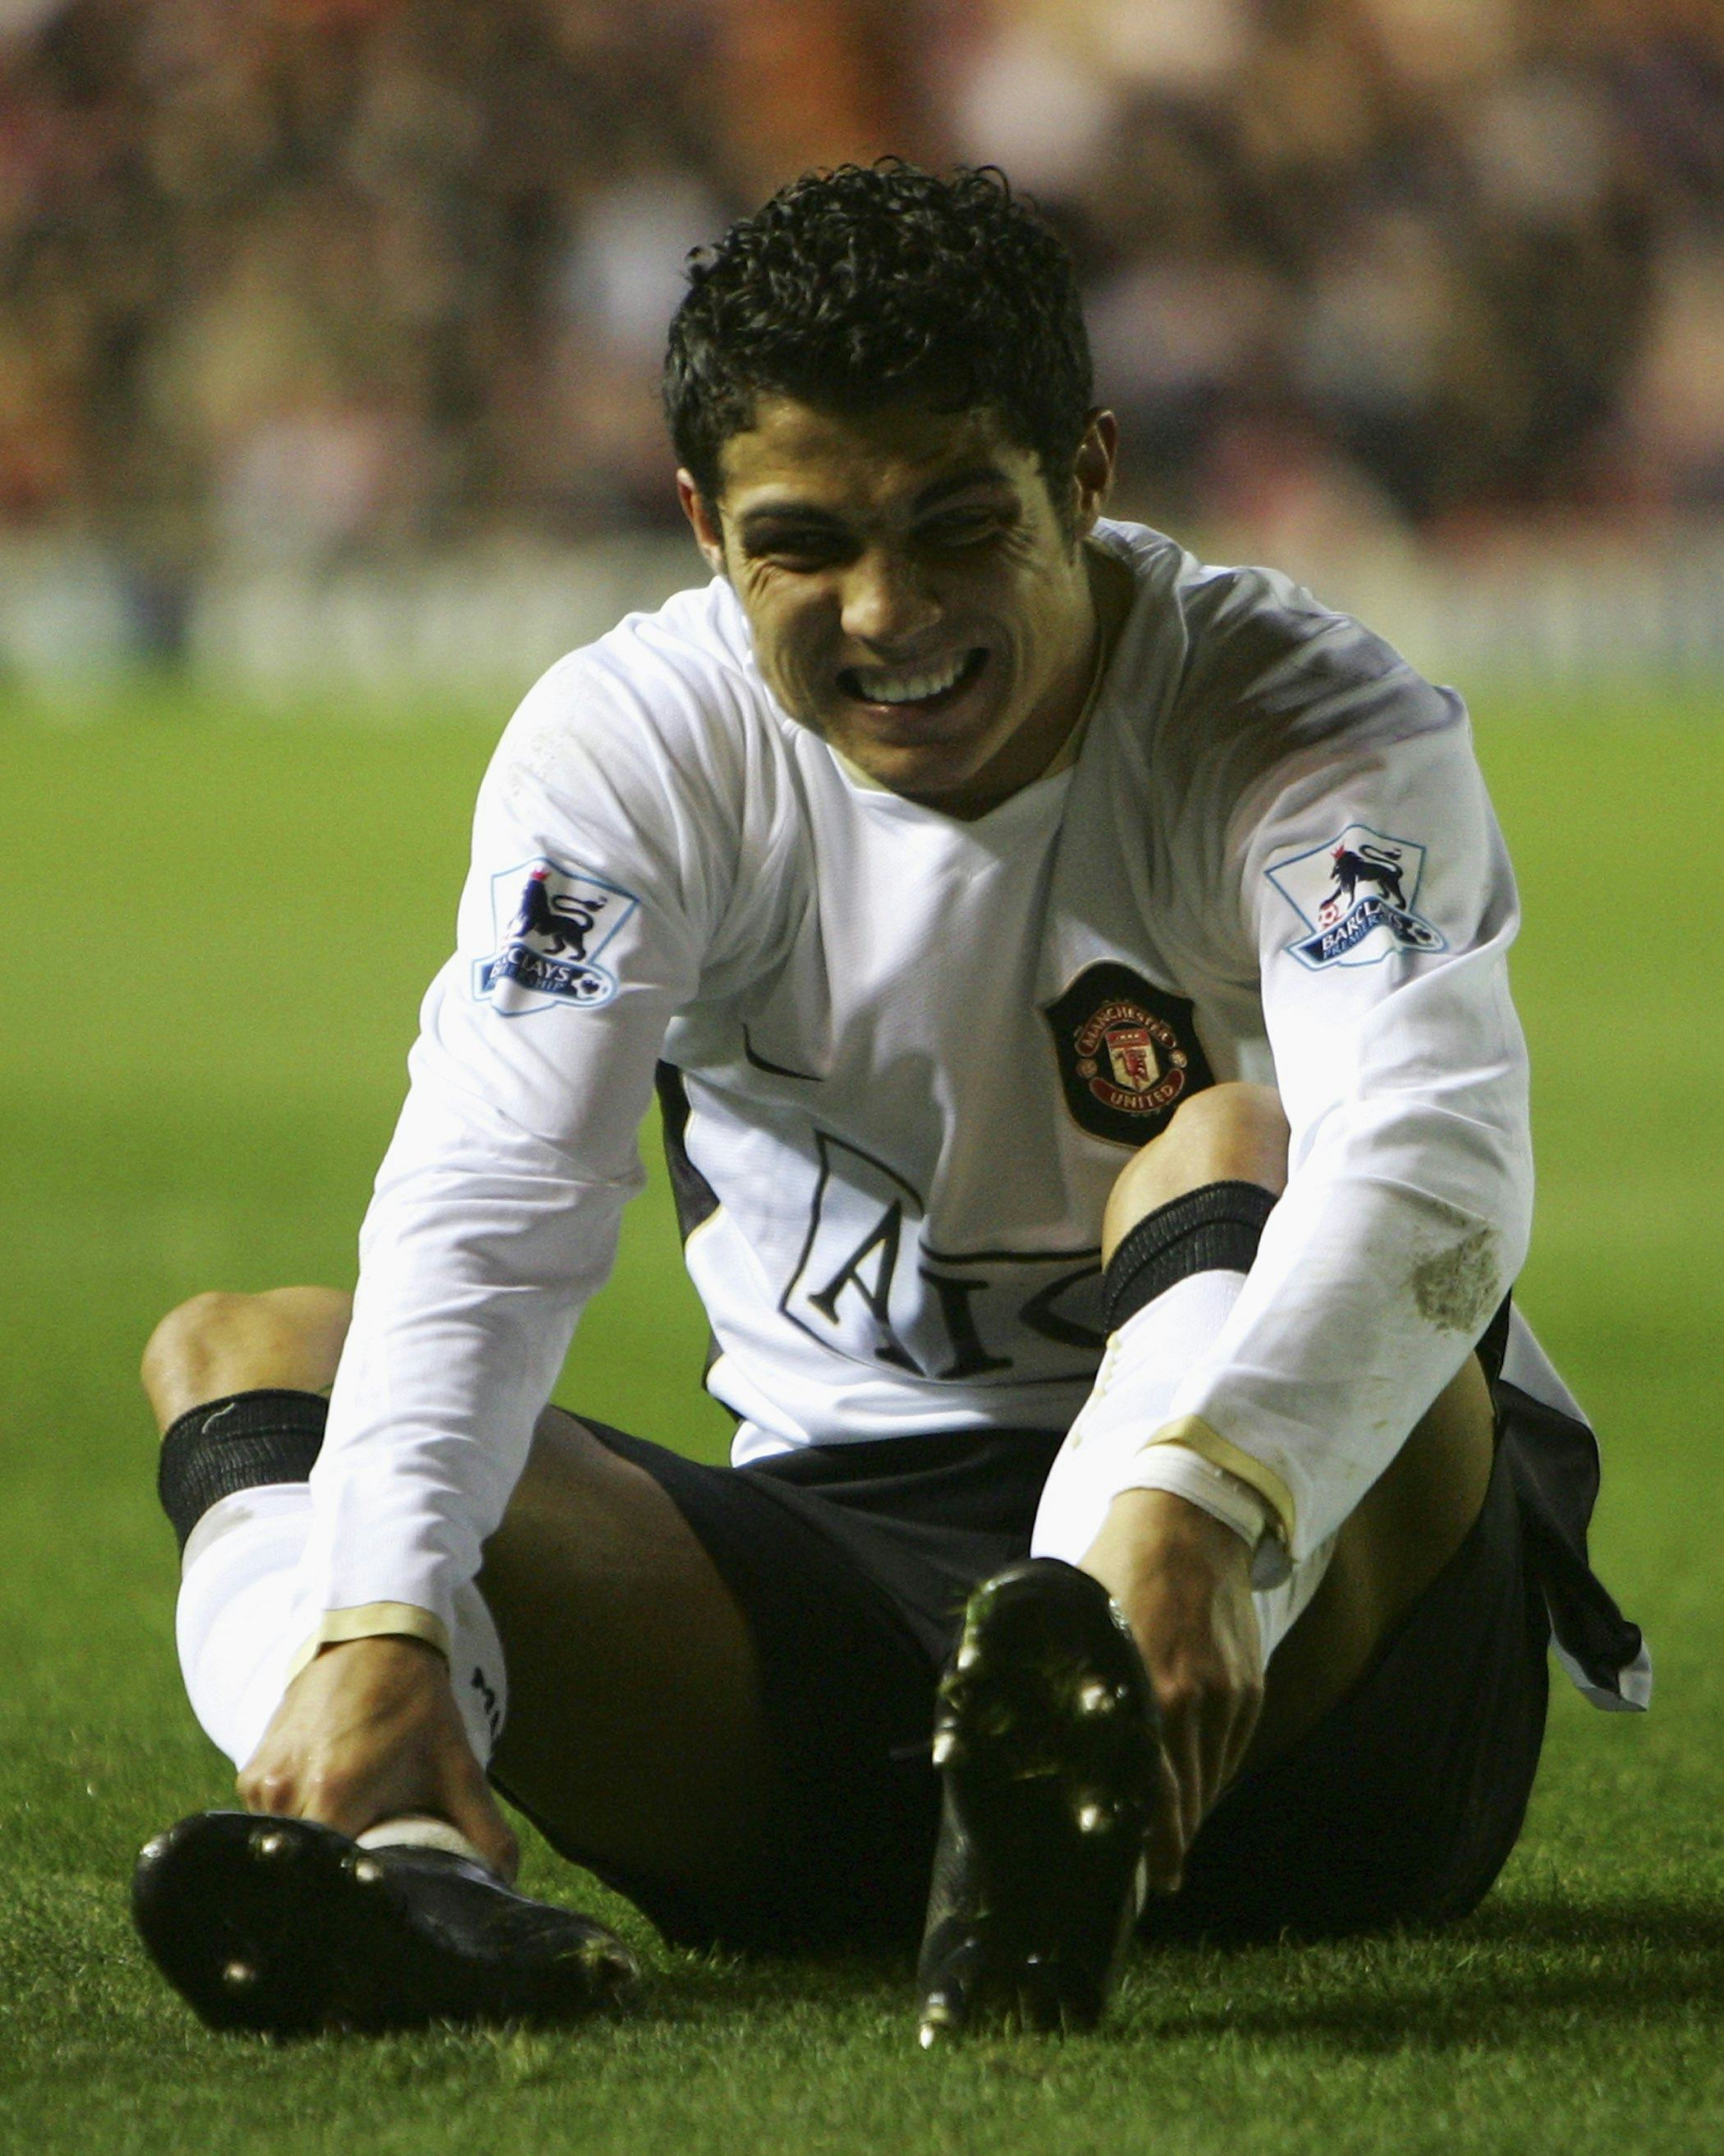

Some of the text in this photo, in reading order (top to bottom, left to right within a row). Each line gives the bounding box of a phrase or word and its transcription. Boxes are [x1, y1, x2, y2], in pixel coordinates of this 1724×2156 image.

[1321, 901, 1403, 951] BARCLS
[490, 947, 571, 983] CLAYS
[1083, 1007, 1169, 1046] MANCHES
[1110, 1085, 1173, 1108] UNITED
